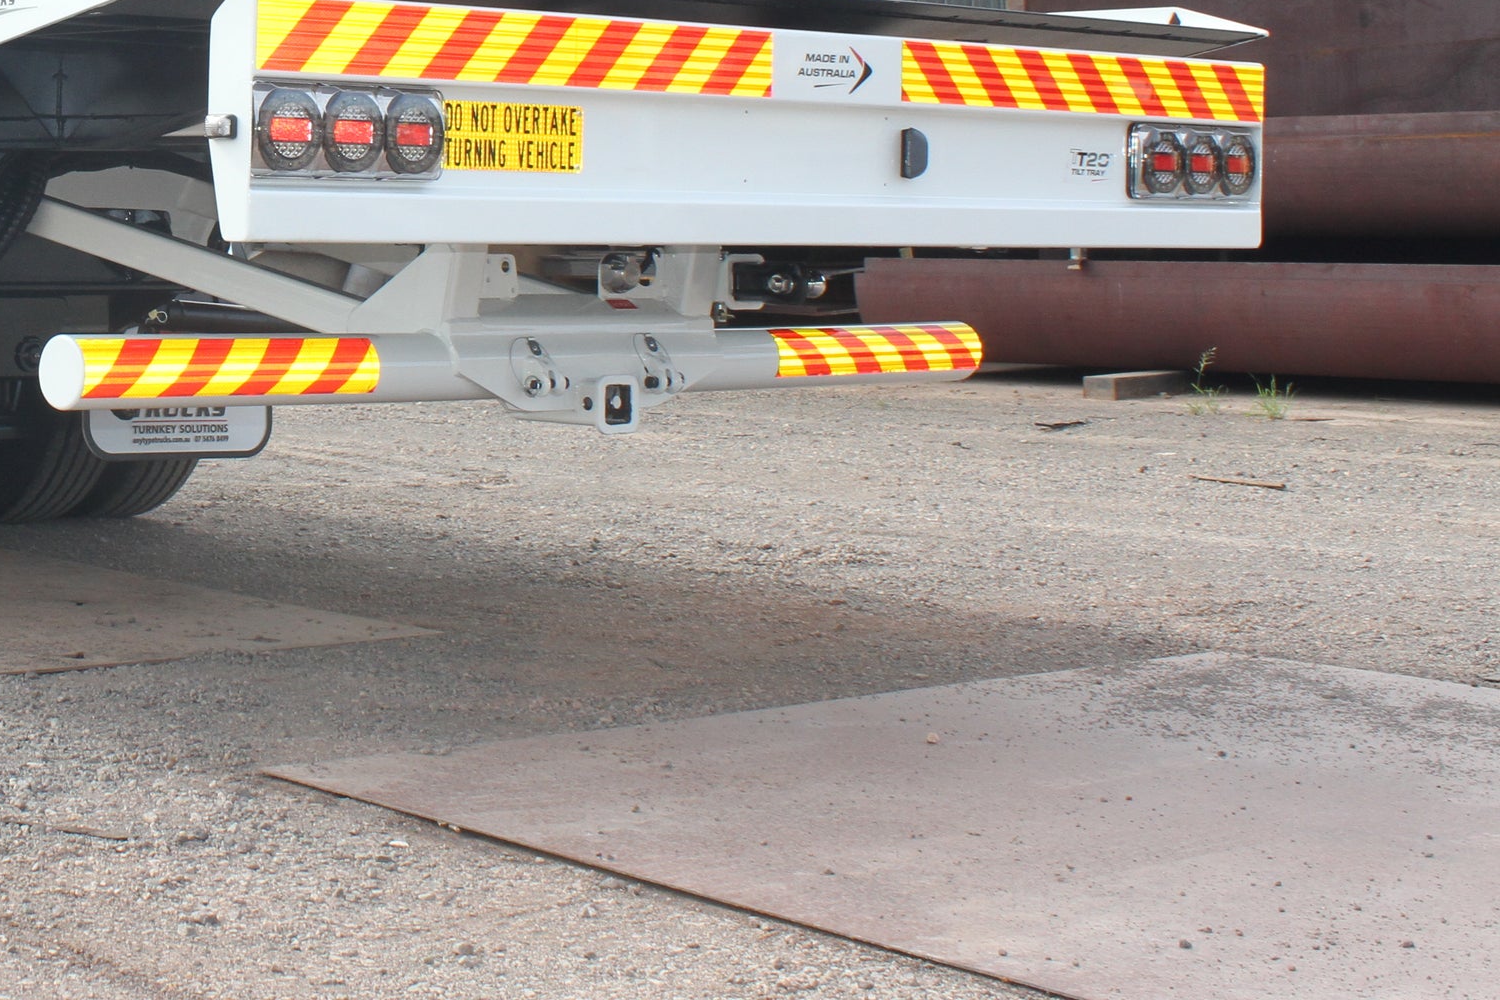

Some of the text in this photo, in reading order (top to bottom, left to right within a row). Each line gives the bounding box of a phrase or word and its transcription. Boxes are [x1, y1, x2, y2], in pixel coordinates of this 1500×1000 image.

[805, 53, 850, 64] MADE IN
[798, 67, 856, 79] AUSTRALIA
[445, 102, 577, 137] DO NOT OVERTAKE
[445, 137, 575, 171] TURNING VEHICLE
[1076, 151, 1110, 168] T20
[1071, 168, 1105, 176] TILT TRAY
[132, 423, 228, 434] TURNKEY SOLUTIONS
